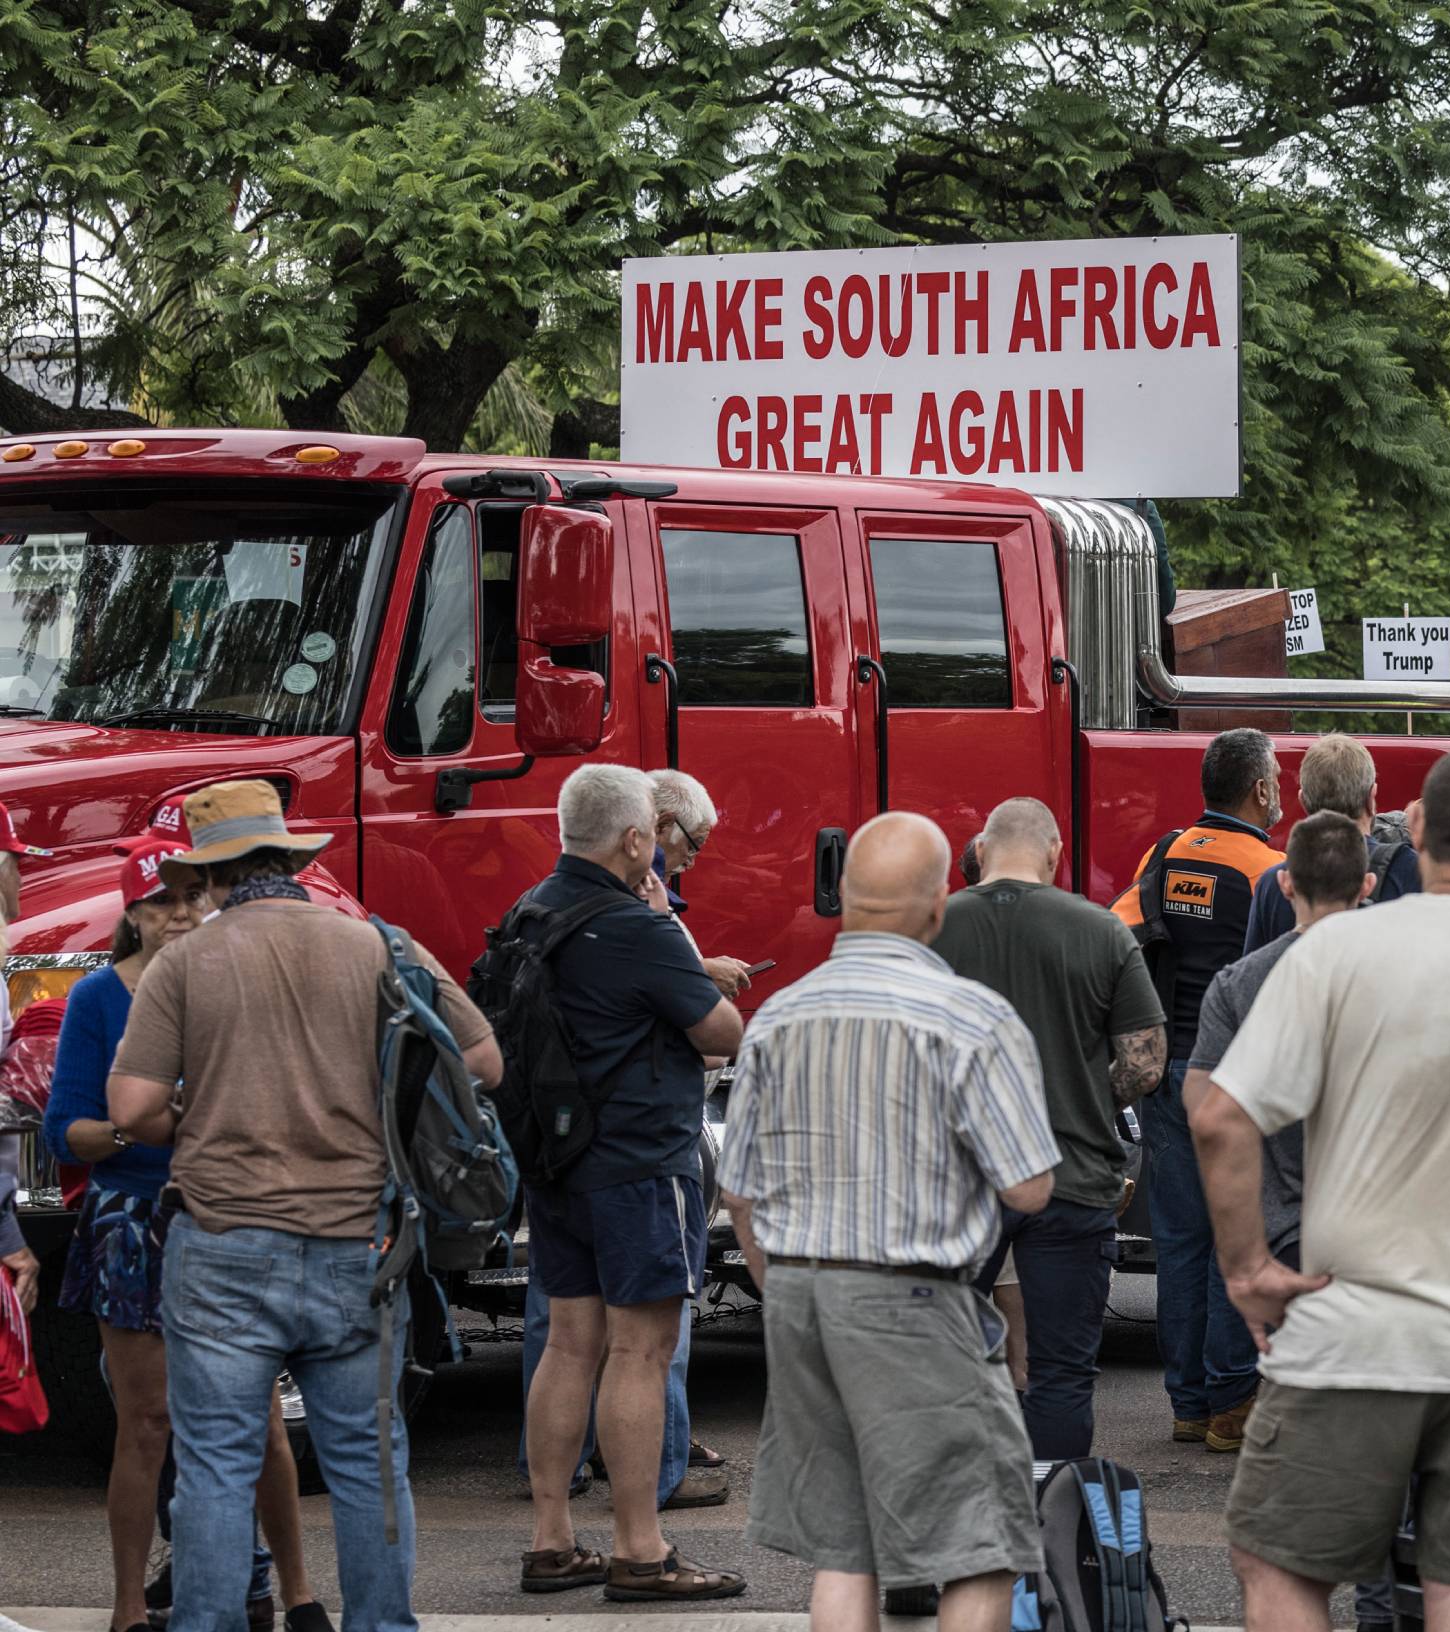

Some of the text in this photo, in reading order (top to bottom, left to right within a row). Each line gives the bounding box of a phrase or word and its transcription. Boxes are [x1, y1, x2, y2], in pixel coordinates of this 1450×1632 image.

[635, 261, 1221, 364] MAKE SOUTH AFRICA
[717, 388, 1084, 476] GREAT AGAIN
[1291, 593, 1314, 610] TOP
[1366, 622, 1450, 646] Thank you
[1382, 651, 1434, 675] Trump
[157, 805, 181, 826] GA
[1172, 880, 1208, 898] KTM
[1165, 901, 1212, 916] RACING TEAM
